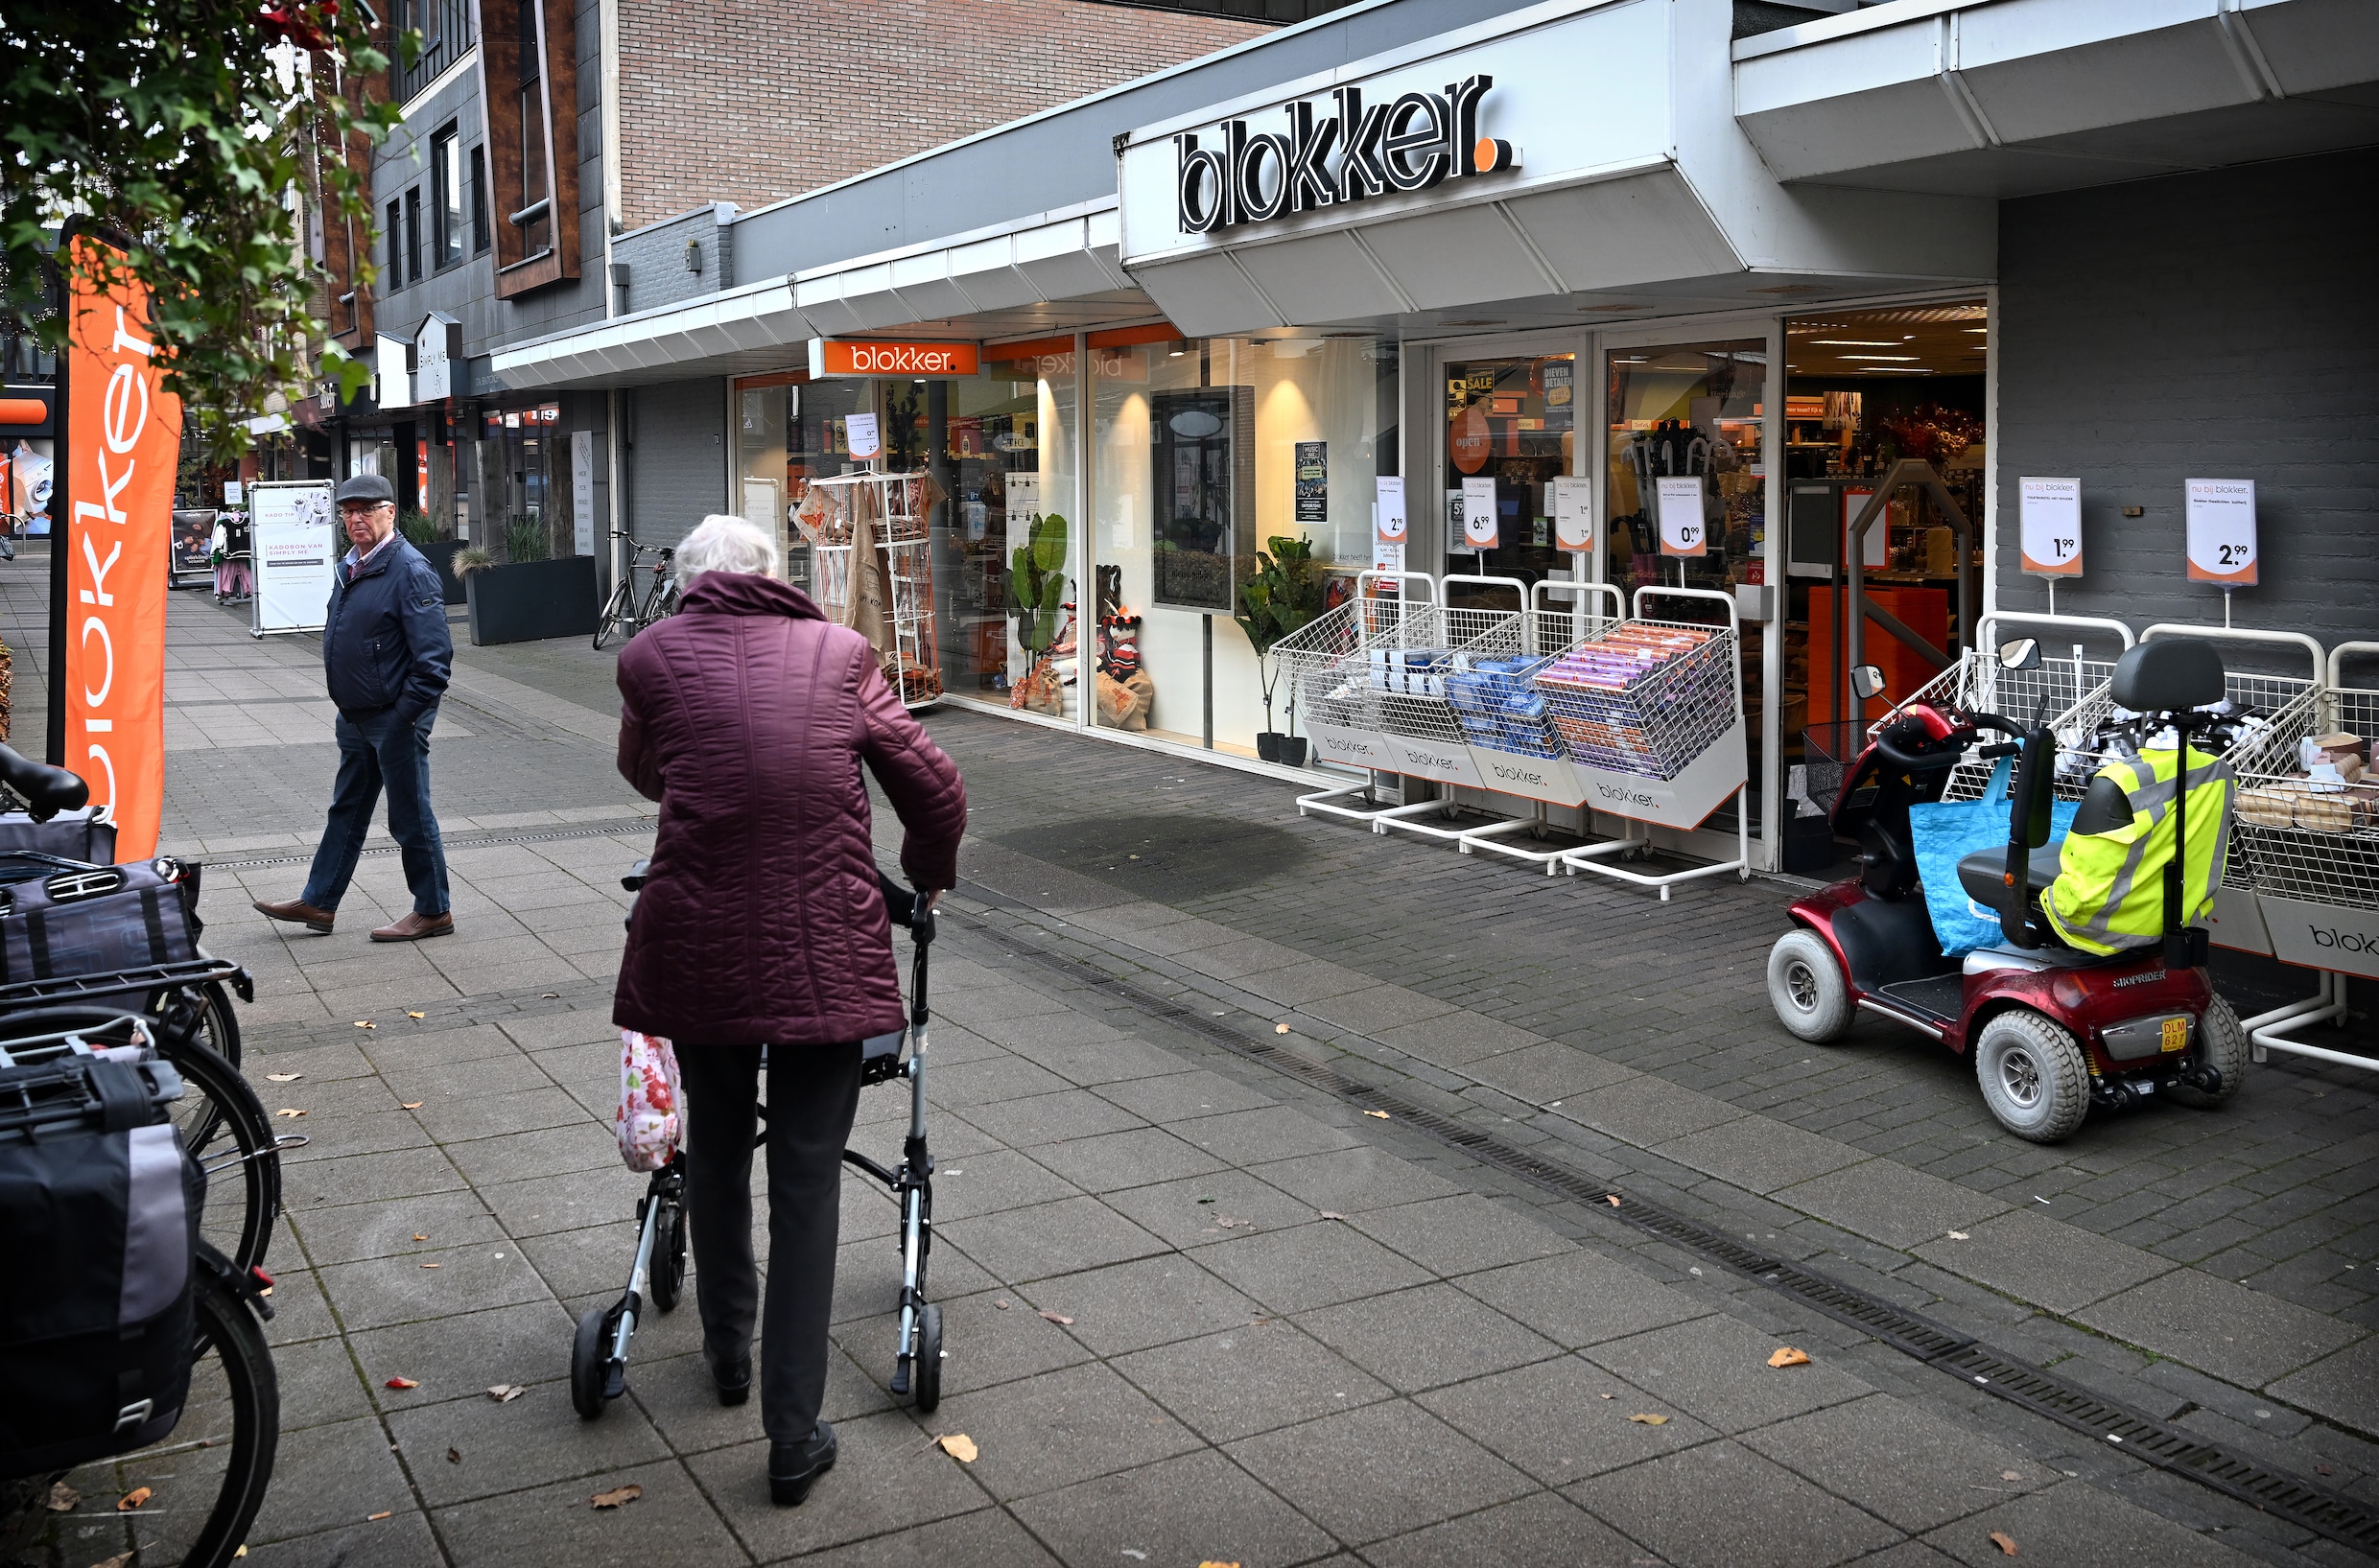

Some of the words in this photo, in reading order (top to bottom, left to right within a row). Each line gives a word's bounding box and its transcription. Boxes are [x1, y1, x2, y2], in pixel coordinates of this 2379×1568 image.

[1173, 74, 1513, 234] blokker.
[437, 350, 447, 363] ME
[851, 346, 956, 372] blokker.
[1544, 366, 1569, 378] DIEVEN
[1467, 377, 1493, 390] SALE
[1544, 377, 1573, 388] BETALEN
[2036, 483, 2044, 492] bij
[2204, 485, 2213, 495] bij
[2215, 485, 2249, 494] blokker.
[1391, 518, 1402, 531] 2.99
[1473, 516, 1490, 530] 6.99
[1682, 527, 1700, 543] 0.99
[2054, 539, 2075, 558] 1.99
[2219, 544, 2249, 566] 2.99
[1325, 736, 1374, 756] blokker.
[1405, 749, 1459, 771] blokker.
[1492, 762, 1548, 786] blokker.
[1596, 783, 1660, 808] blokker.
[2113, 970, 2167, 988] SHOPRIDER
[2164, 1021, 2185, 1034] DLM
[2165, 1033, 2184, 1046] 627
